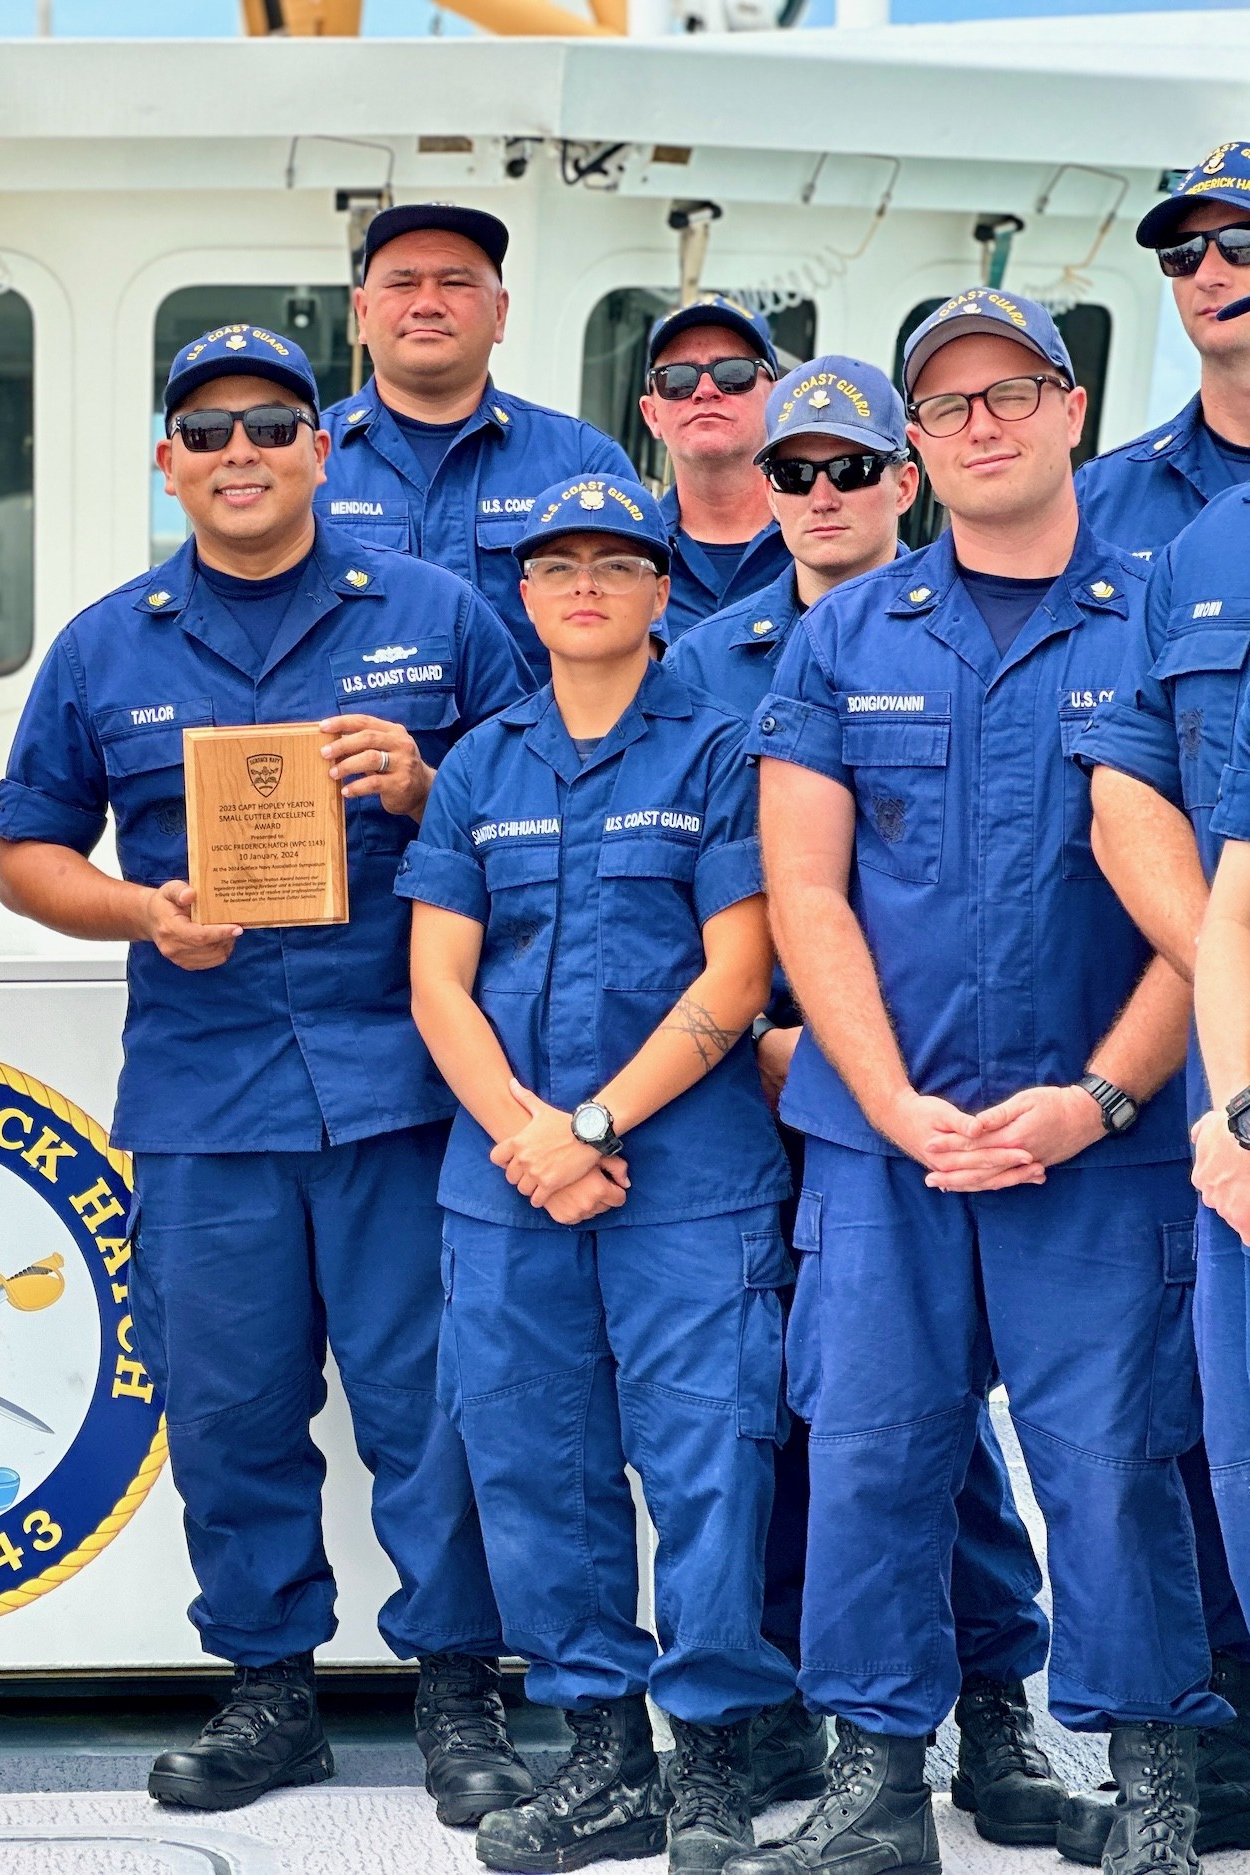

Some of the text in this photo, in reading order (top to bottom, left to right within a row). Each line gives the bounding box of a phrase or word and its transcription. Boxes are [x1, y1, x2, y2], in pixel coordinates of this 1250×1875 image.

[938, 291, 1027, 327] COAST GUARD
[186, 325, 289, 361] U.S. COAST GUARD
[778, 373, 870, 422] U.S. COAST GUARD
[330, 501, 383, 516] MENDIOLA
[482, 499, 503, 513] U.S.
[540, 482, 644, 523] U.S. COAST GUARD
[342, 664, 443, 693] U.S. COAST GUARD
[1071, 691, 1097, 708] U.S.
[131, 706, 174, 725] TAYLOR
[258, 802, 286, 810] HOPLEY
[219, 811, 315, 823] SMALL CUTTER EXCELLENCE
[606, 811, 700, 832] U.S. COAST GUARD
[498, 818, 559, 837] CHIHUAHUA
[211, 844, 232, 852] USCGC
[234, 842, 266, 850] FREDERICK
[290, 840, 307, 848] (WPC
[250, 852, 279, 861] January,
